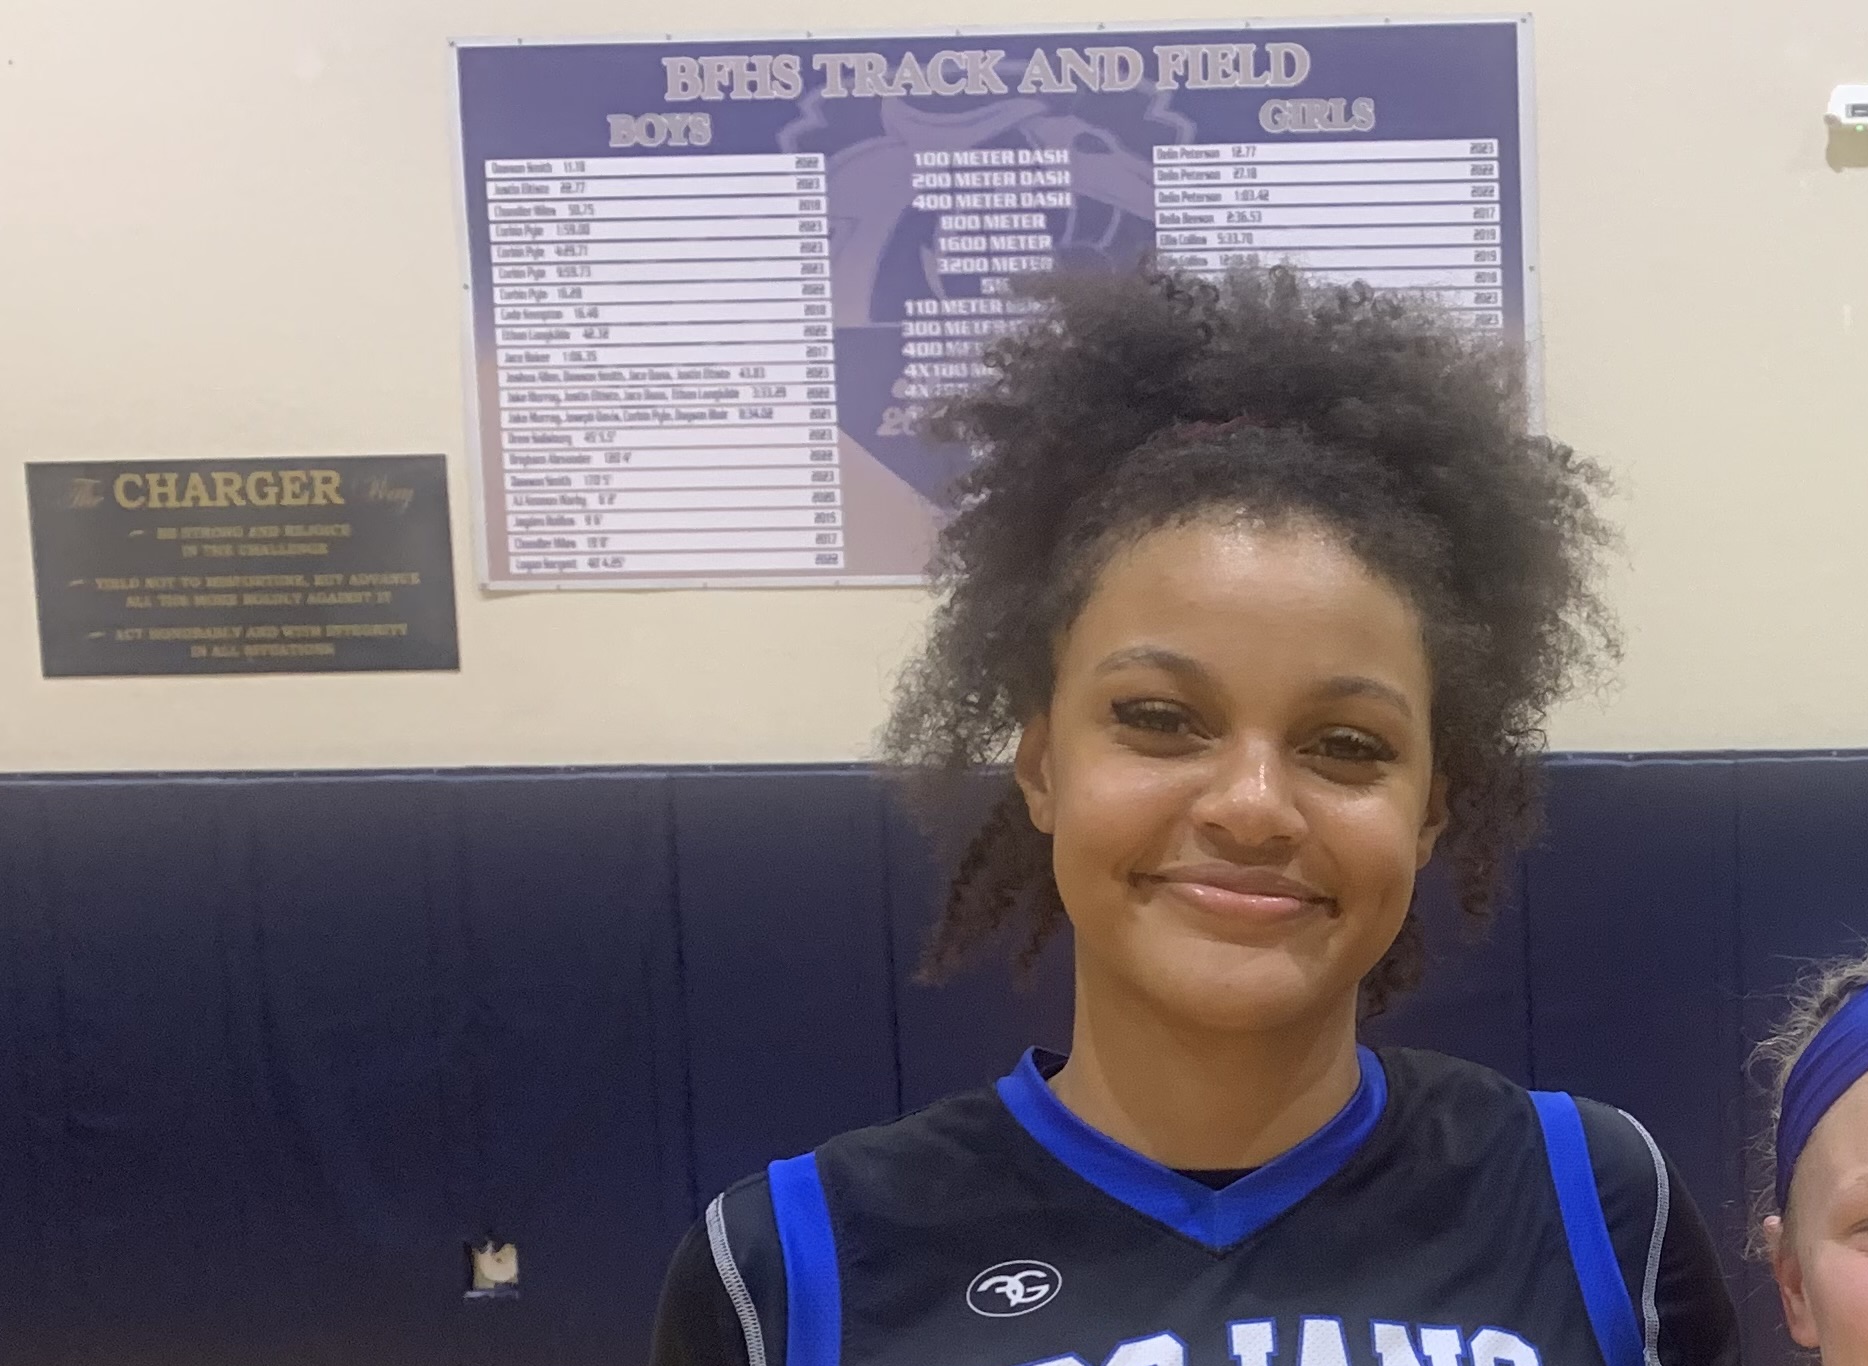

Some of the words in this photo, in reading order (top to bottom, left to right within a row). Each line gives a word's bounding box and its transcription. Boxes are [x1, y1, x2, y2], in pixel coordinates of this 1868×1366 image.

[662, 54, 801, 100] BFHS
[812, 50, 1007, 98] TRACK
[1017, 46, 1144, 93] AND
[1152, 42, 1310, 90] FIELD
[1259, 97, 1375, 133] GIRLS
[607, 112, 712, 147] BOYS
[1470, 142, 1494, 154] 2023
[914, 152, 950, 166] 100
[953, 150, 1014, 166] METER
[1019, 149, 1070, 164] DASH
[912, 173, 951, 188] 200
[955, 172, 1016, 187] METER
[1020, 170, 1070, 186] DASH
[912, 194, 952, 210] 400
[956, 193, 1016, 209] METER
[1021, 192, 1072, 208] DASH
[941, 215, 980, 230] 800
[983, 213, 1046, 229] METER
[1473, 207, 1496, 220] 2017
[938, 236, 986, 252] 1600
[990, 234, 1052, 250] METER
[937, 258, 989, 274] 3200
[991, 256, 1053, 272] METER
[904, 299, 938, 316] 110
[941, 299, 1003, 315] METER
[902, 321, 941, 338] 300
[113, 469, 345, 510] CHARGER
